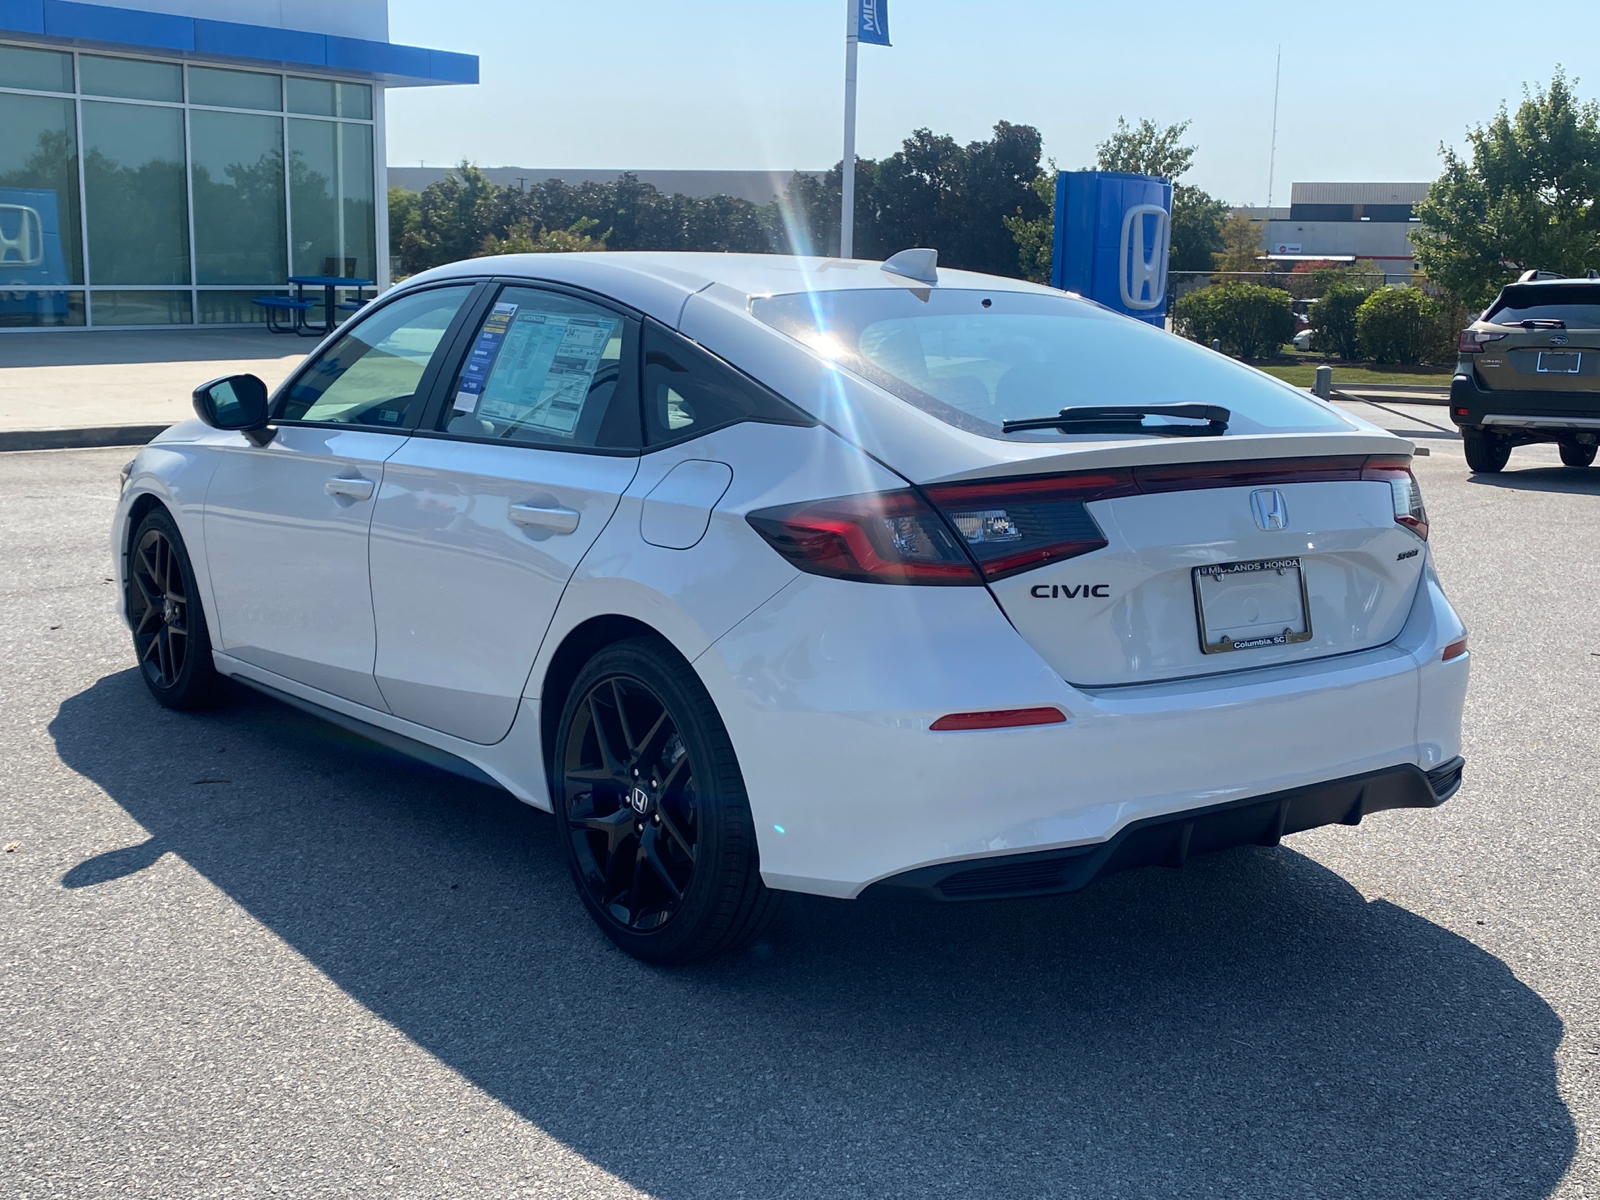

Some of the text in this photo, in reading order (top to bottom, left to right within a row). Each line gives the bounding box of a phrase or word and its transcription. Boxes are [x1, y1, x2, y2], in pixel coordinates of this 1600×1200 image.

[1264, 559, 1299, 569] HONDA
[1030, 584, 1110, 599] CIVIC
[1233, 636, 1285, 649] Columbia, SC
